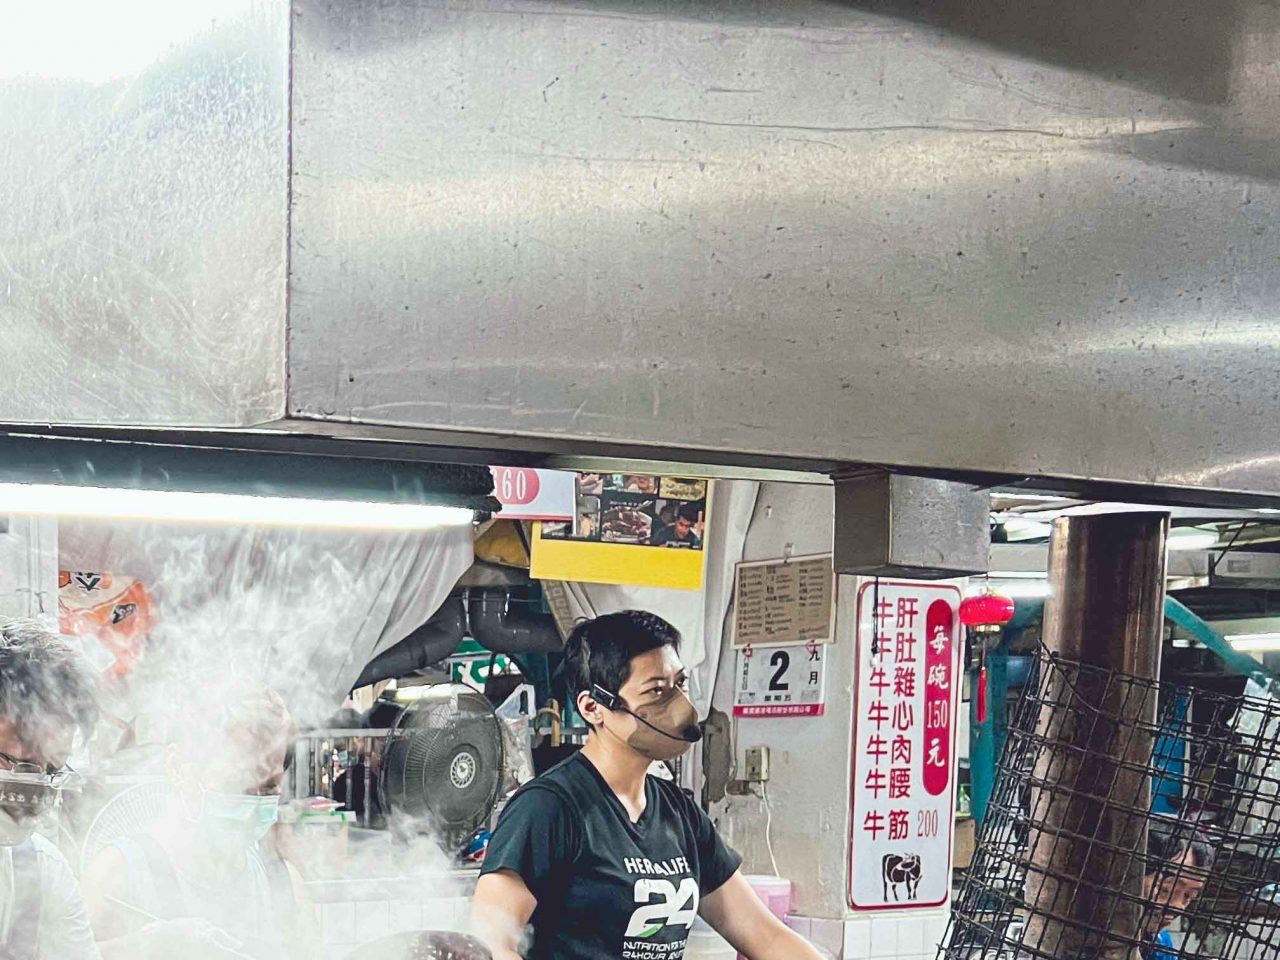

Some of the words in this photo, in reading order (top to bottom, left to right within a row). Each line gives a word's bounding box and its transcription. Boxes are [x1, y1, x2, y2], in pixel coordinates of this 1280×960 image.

[873, 596, 918, 628] 牛肝
[872, 632, 917, 663] 牛肚
[769, 650, 790, 691] 2
[869, 667, 915, 697] 牛雜
[868, 700, 913, 730] 牛心
[866, 734, 912, 765] 牛肉
[865, 768, 911, 799] 牛腰
[863, 809, 910, 841] 牛筋
[917, 809, 938, 837] 200
[624, 877, 699, 937] 24
